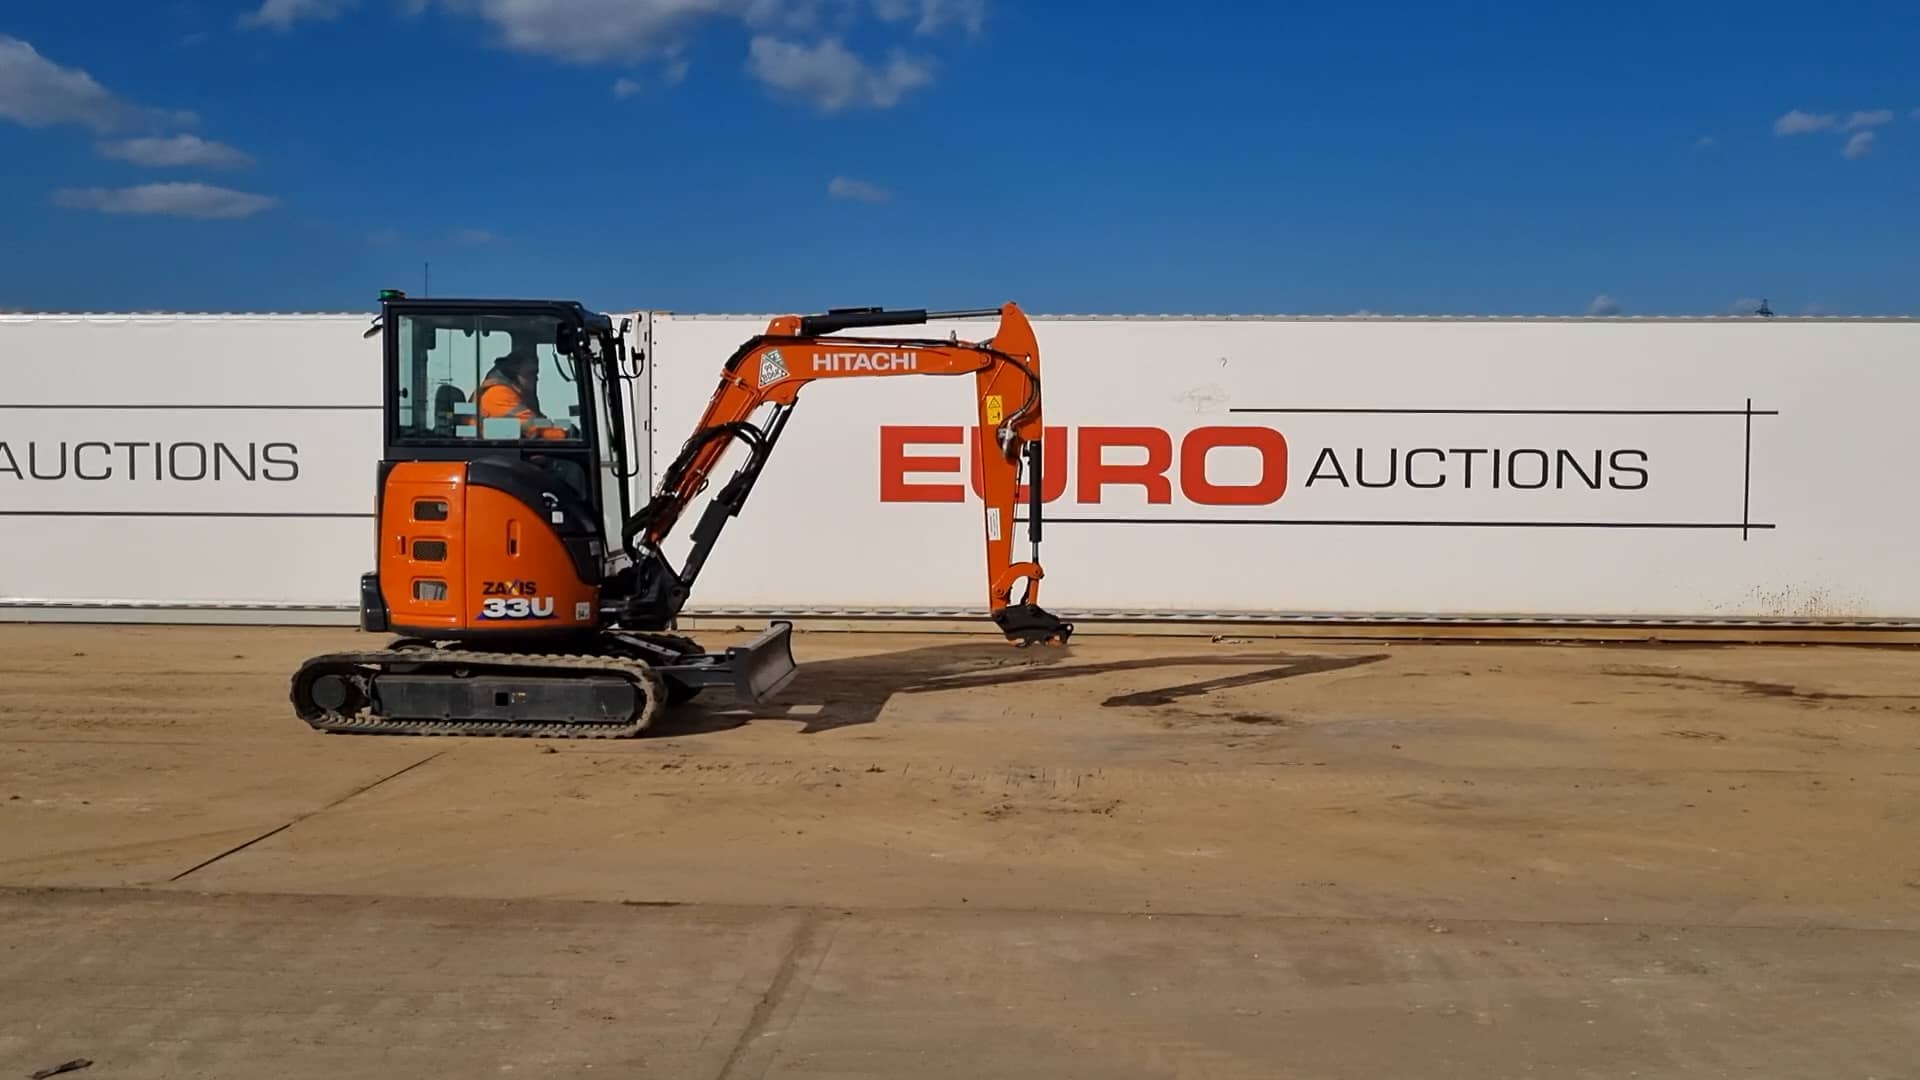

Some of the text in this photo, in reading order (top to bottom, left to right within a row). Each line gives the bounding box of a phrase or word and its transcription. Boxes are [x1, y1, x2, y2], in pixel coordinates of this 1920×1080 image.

[813, 352, 917, 371] HITACHI
[0, 441, 299, 481] AUCTIONS
[1305, 447, 1649, 490] AUCTIONS
[482, 580, 537, 595] ZAXIS
[482, 597, 554, 618] 33U
